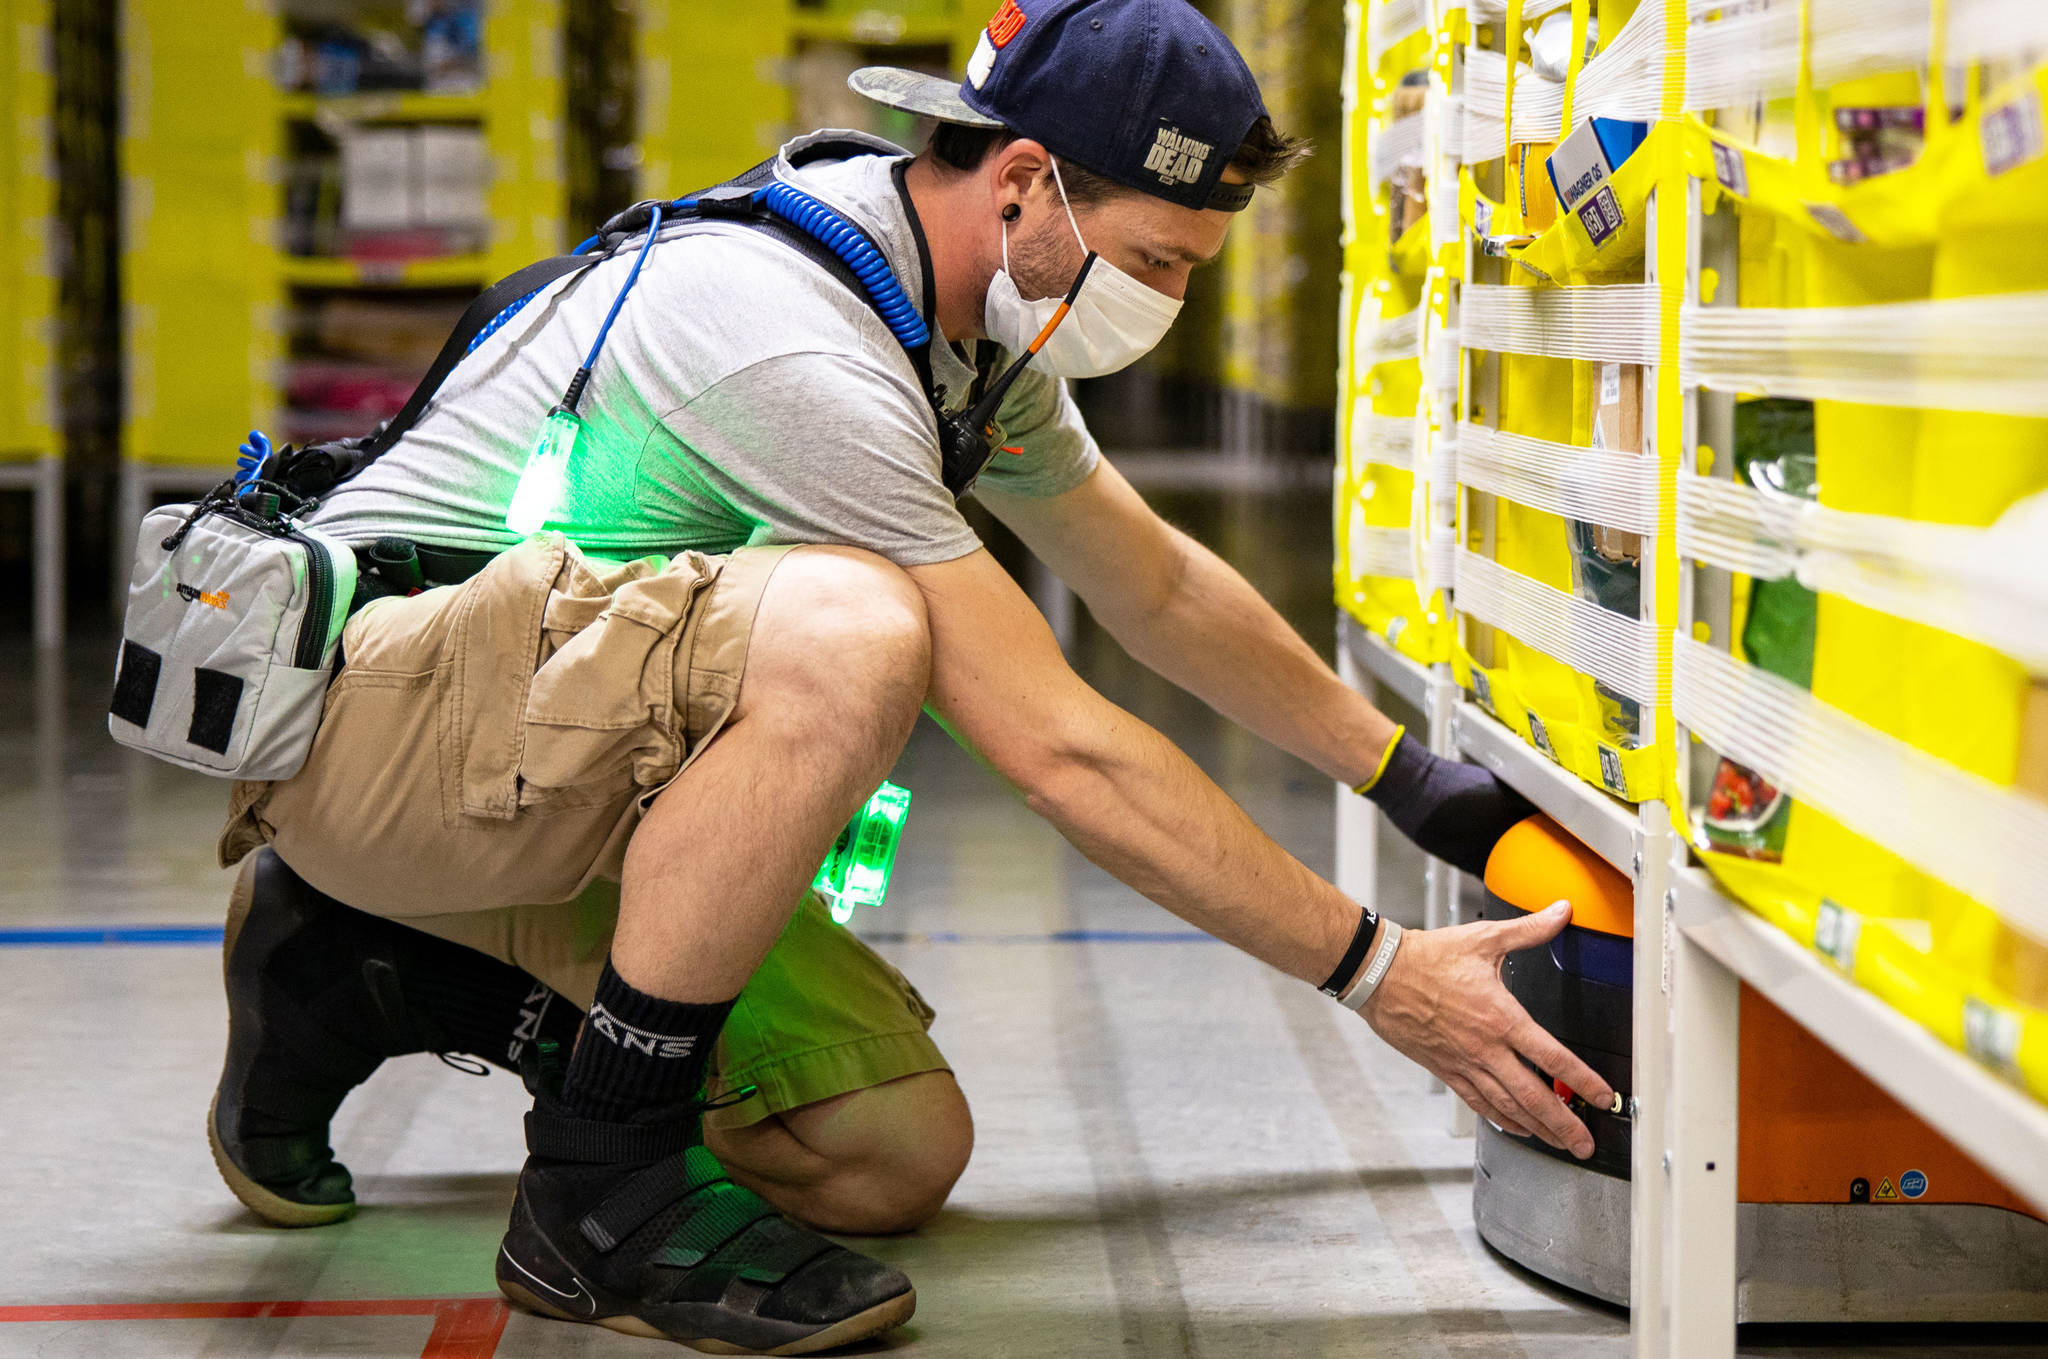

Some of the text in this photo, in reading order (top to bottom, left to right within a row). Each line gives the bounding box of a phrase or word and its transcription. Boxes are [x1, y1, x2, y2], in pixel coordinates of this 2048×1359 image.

[1143, 143, 1203, 184] DEAD
[1156, 127, 1210, 161] WALKING
[507, 982, 554, 1062] ANS
